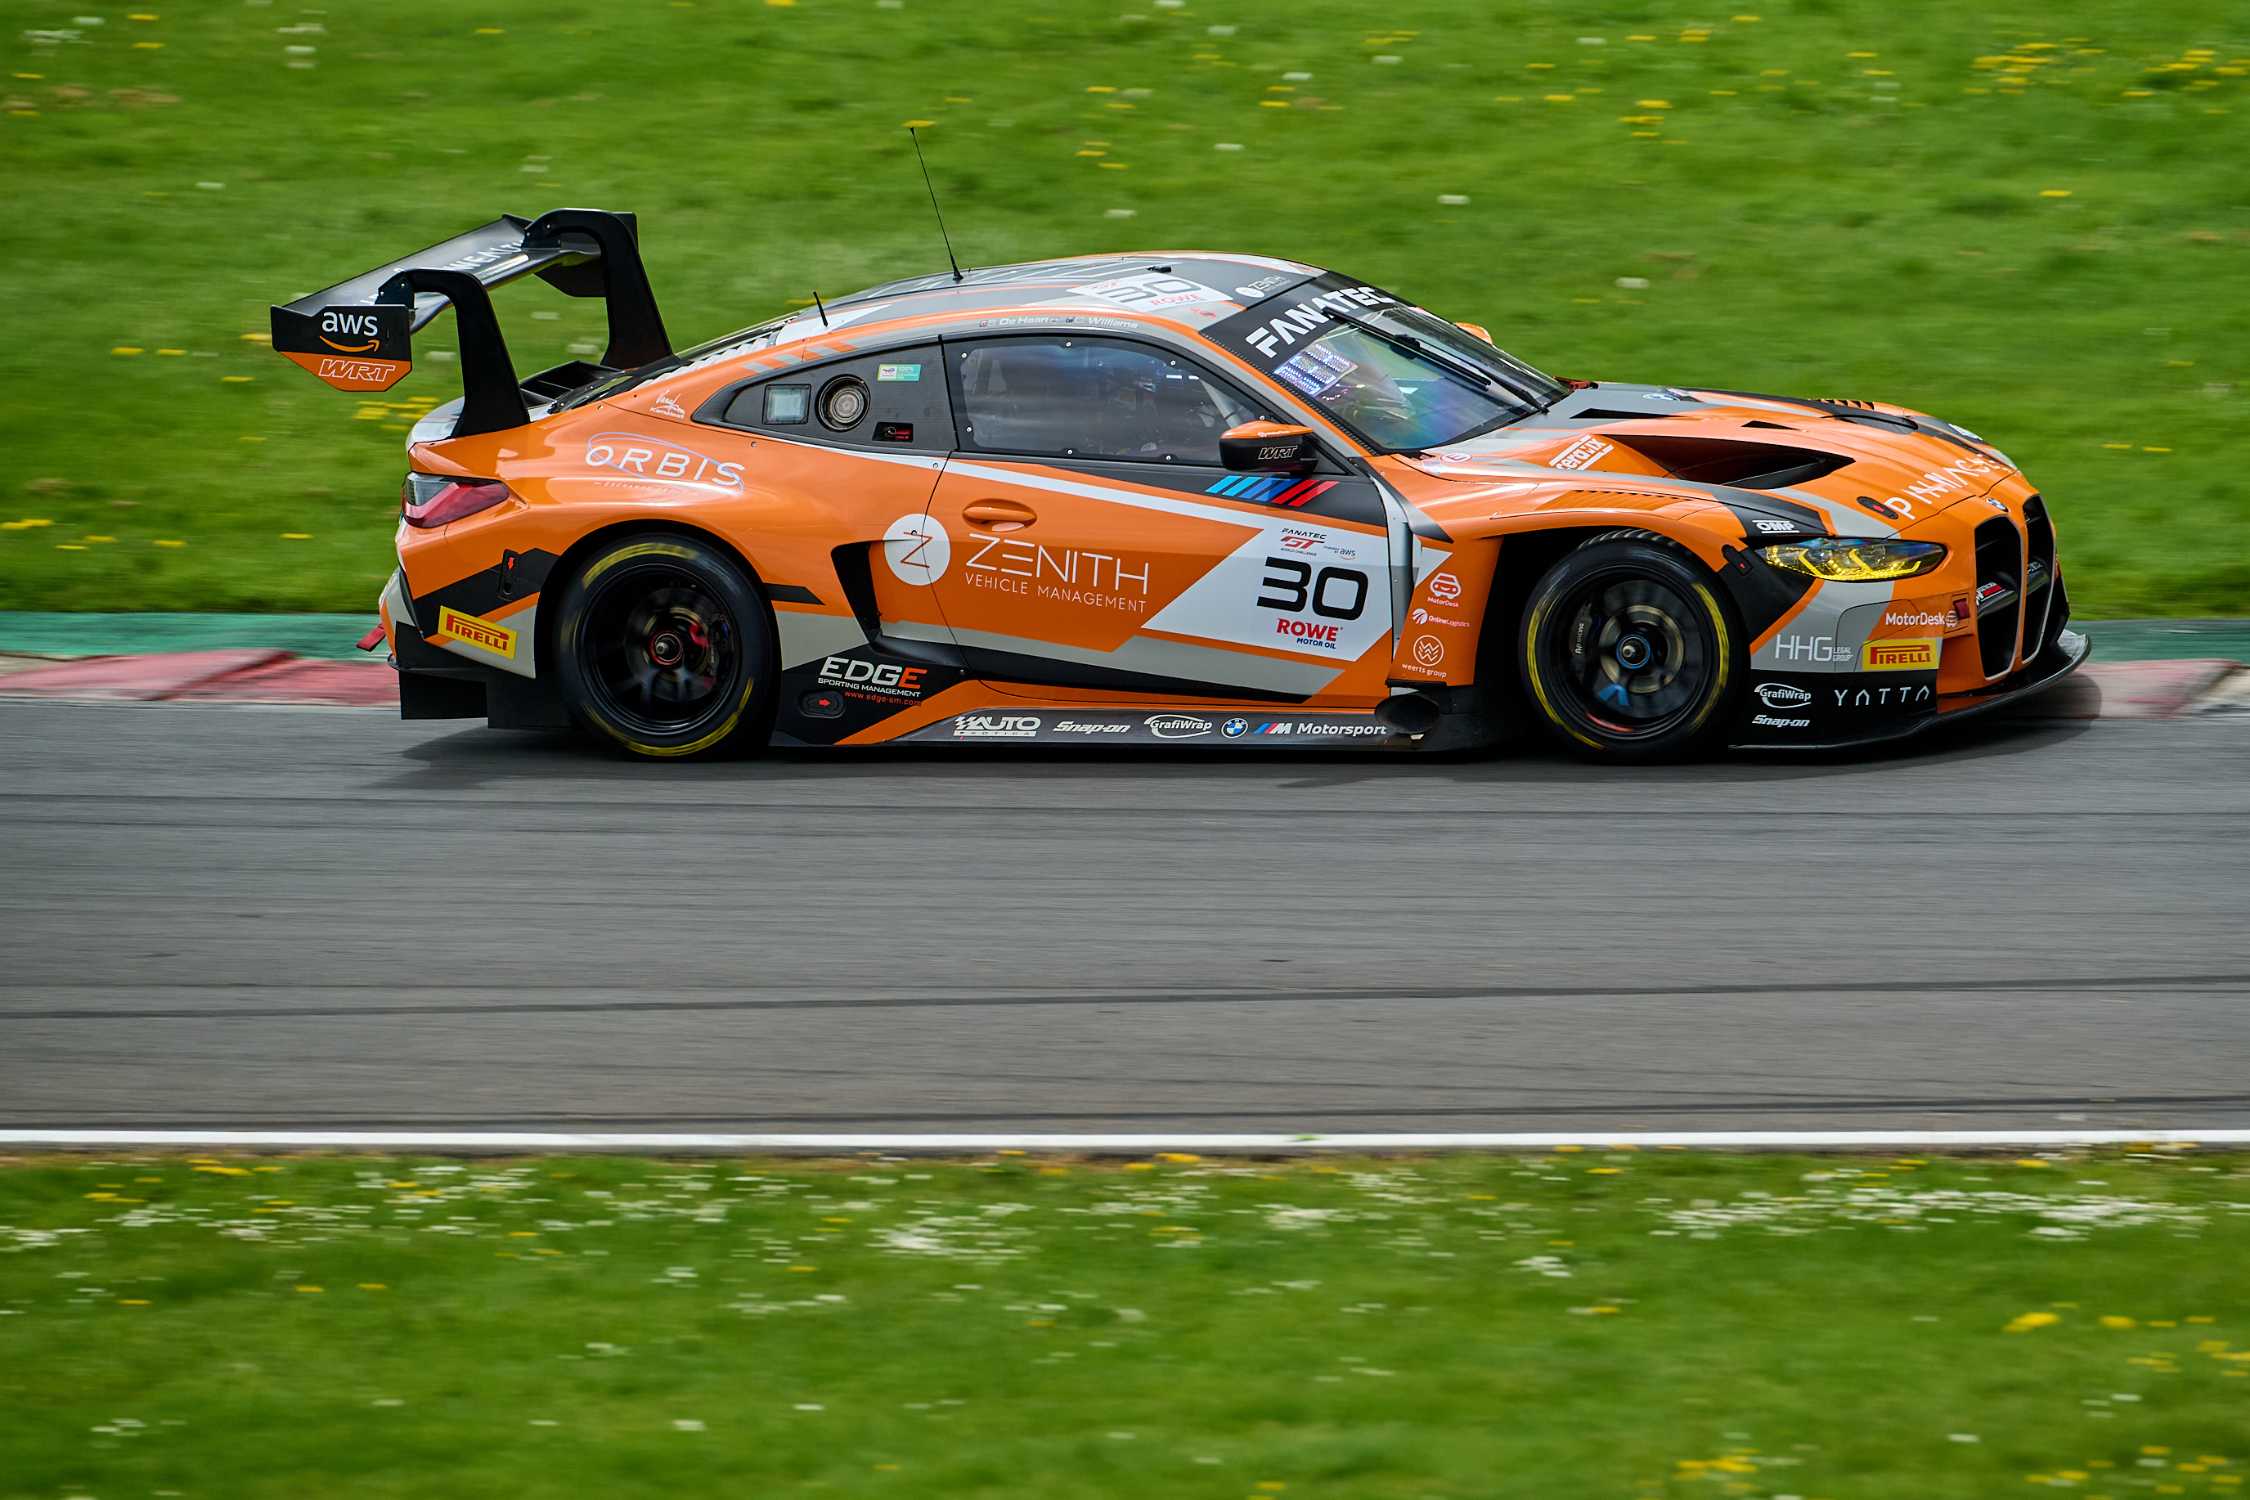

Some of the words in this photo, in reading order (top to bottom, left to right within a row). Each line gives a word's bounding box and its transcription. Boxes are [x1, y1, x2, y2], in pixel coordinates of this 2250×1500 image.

[1096, 279, 1202, 303] 30
[321, 311, 378, 337] aws
[1245, 286, 1396, 359] FANATEC
[319, 359, 396, 382] WRT
[1258, 445, 1298, 460] WRT
[585, 445, 747, 486] ORBIS
[1281, 528, 1328, 540] FANATEC
[1756, 522, 1795, 531] OMP
[966, 533, 1149, 595] ZENITH
[965, 572, 1028, 595] VEHICLE
[1037, 584, 1147, 614] MANAGEMENT
[1256, 556, 1369, 621] 30
[1885, 611, 1945, 626] MotorDesk
[446, 613, 510, 651] PIRELLI
[1276, 618, 1339, 642] ROWE
[1296, 637, 1323, 647] MOTOR
[1775, 634, 1833, 662] HHG
[1869, 644, 1931, 665] PIRELLI
[820, 656, 928, 689] EDGE
[1402, 663, 1426, 674] weerts
[1426, 667, 1447, 678] group
[818, 677, 860, 690] SPORTING
[861, 684, 921, 697] MANAGEMENT
[1760, 687, 1812, 702] GrafiWrap
[1834, 685, 1930, 706] YATTA
[960, 716, 1041, 731] AUTO
[1053, 720, 1131, 735] Snap-on
[1150, 719, 1213, 732] GrafiWrap
[1296, 723, 1387, 737] Motorsport
[1752, 714, 1811, 728] Snap-on
